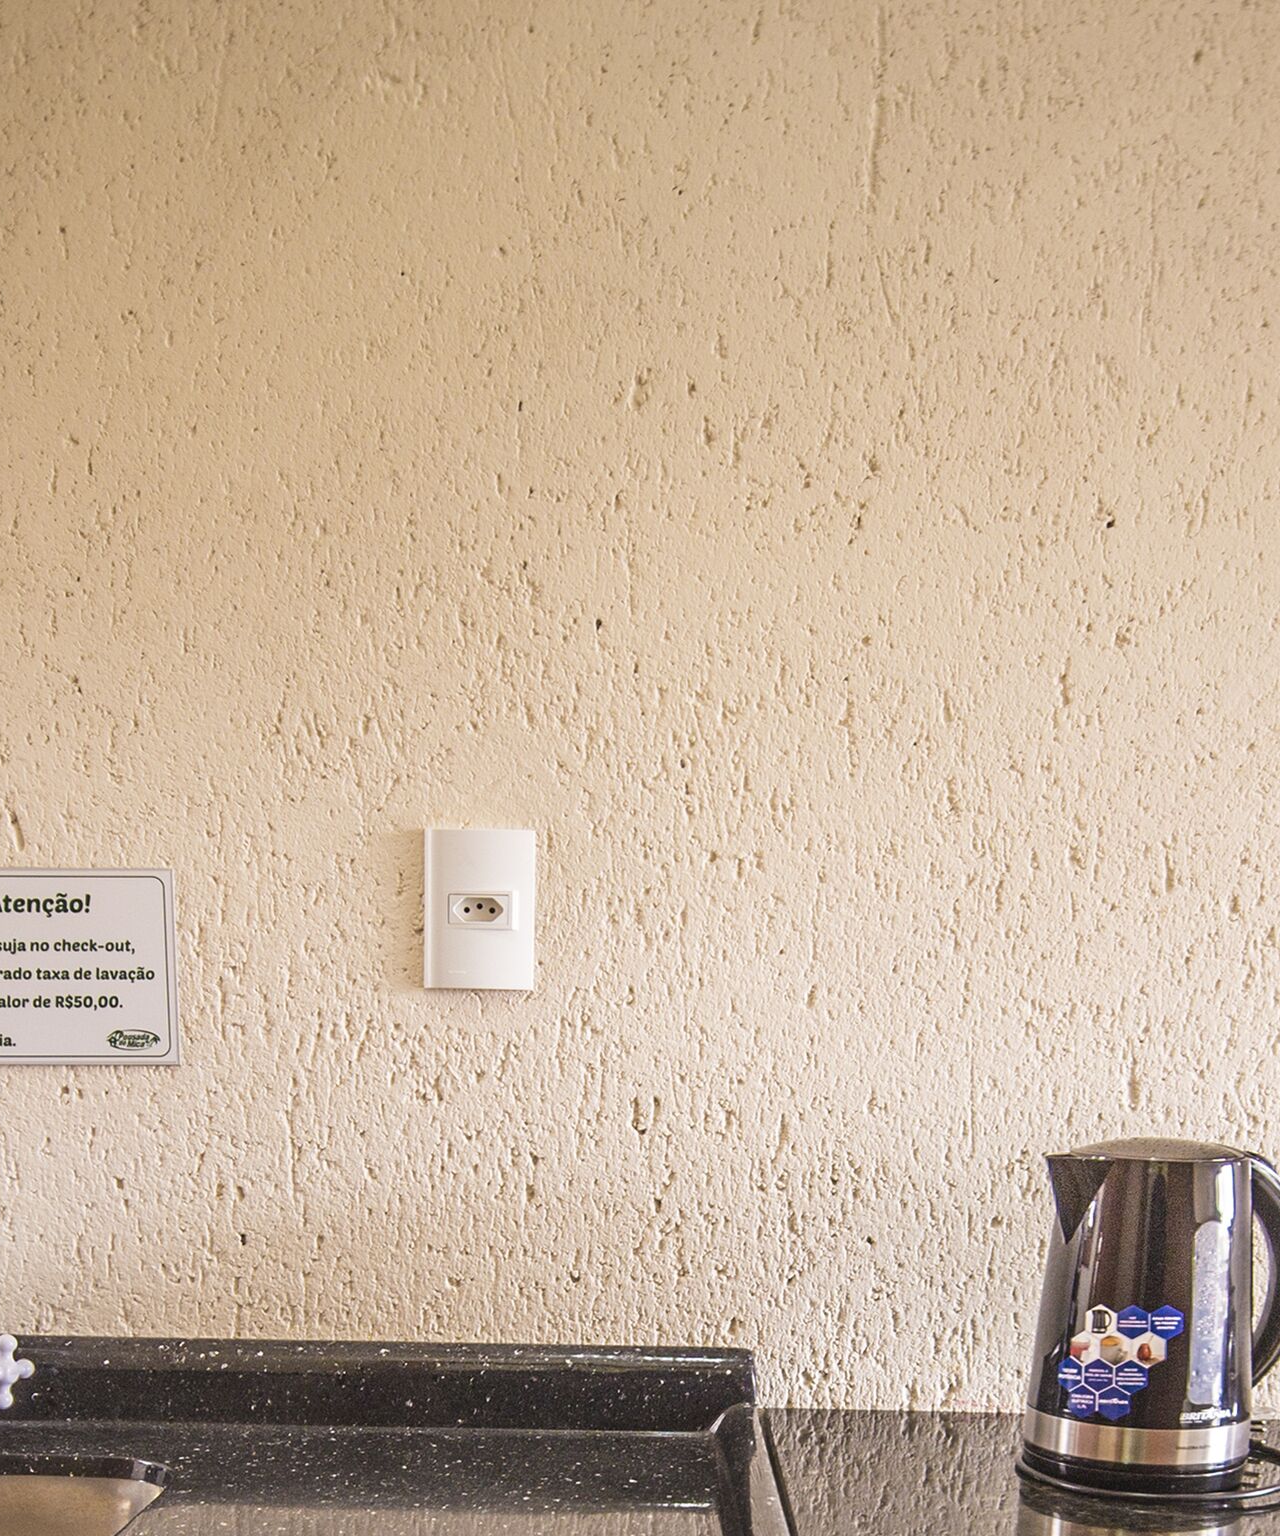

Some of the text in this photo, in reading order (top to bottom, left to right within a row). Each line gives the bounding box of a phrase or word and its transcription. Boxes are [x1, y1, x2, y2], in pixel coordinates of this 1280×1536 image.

[30, 940, 50, 952] no
[53, 939, 135, 954] check-out,
[36, 968, 70, 981] taxa
[73, 967, 92, 981] de
[95, 966, 155, 983] lavação
[33, 995, 52, 1008] de
[55, 995, 123, 1011] R$50,00.
